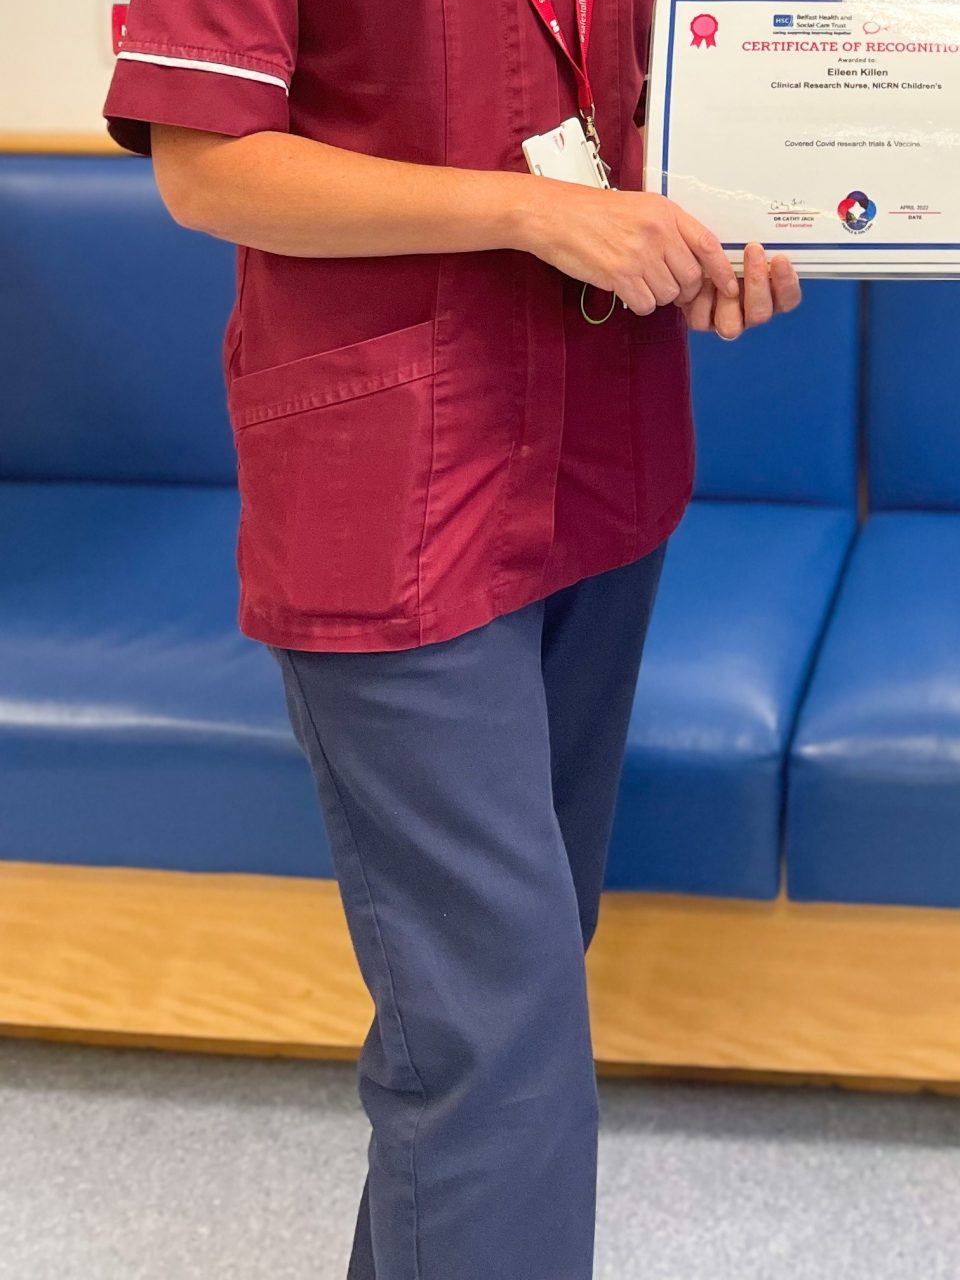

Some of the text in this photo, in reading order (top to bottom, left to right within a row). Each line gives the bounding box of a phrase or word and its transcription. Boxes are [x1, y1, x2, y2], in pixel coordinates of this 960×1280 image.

[742, 41, 839, 52] CERTIFICATE
[842, 41, 861, 52] OF
[827, 68, 888, 77] Eileen Killen
[770, 82, 942, 91] Clinical Research Nurse, NICRN Children's
